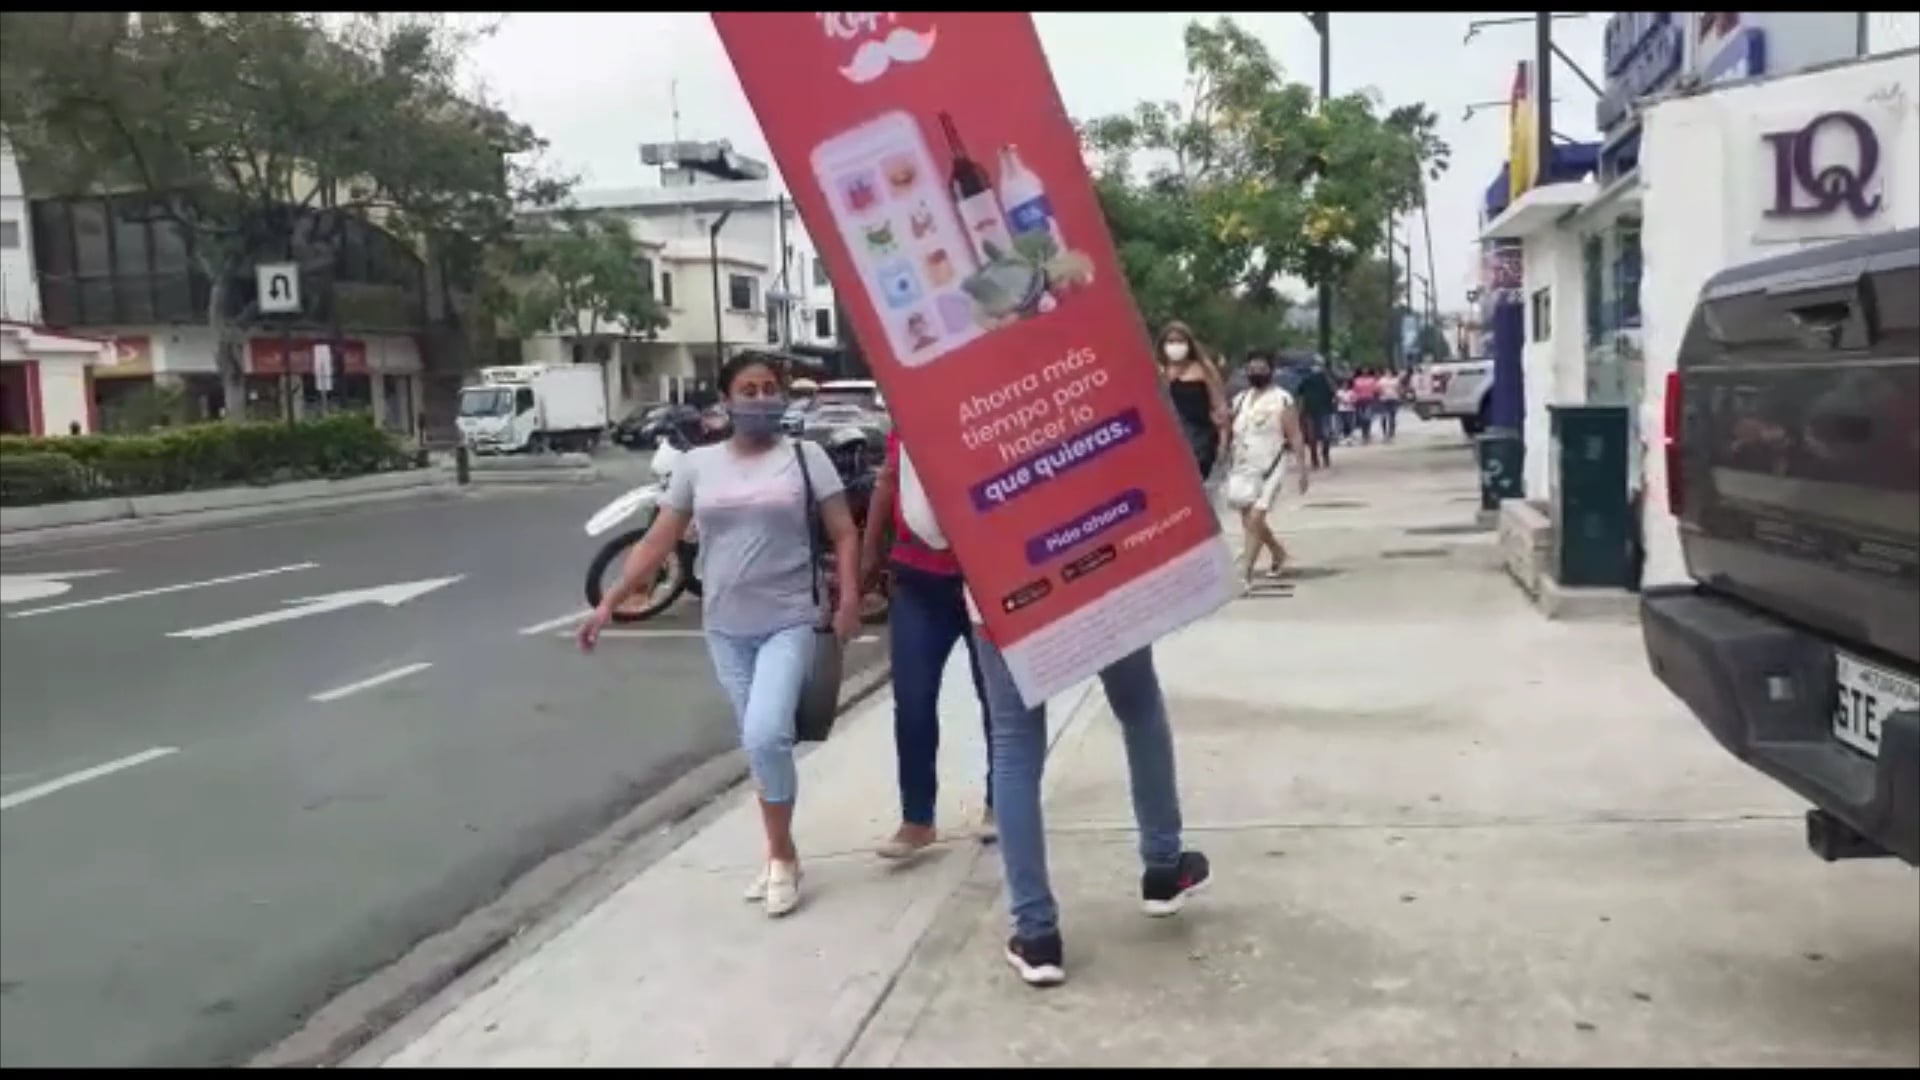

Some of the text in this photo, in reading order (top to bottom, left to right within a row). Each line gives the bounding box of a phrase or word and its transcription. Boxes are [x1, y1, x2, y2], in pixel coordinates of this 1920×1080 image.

[958, 346, 1097, 425] Ahorra más
[961, 399, 1050, 451] tiempo
[998, 405, 1094, 463] hacer lo
[984, 420, 1131, 502] que quieras.
[1045, 500, 1130, 552] Pide ahora
